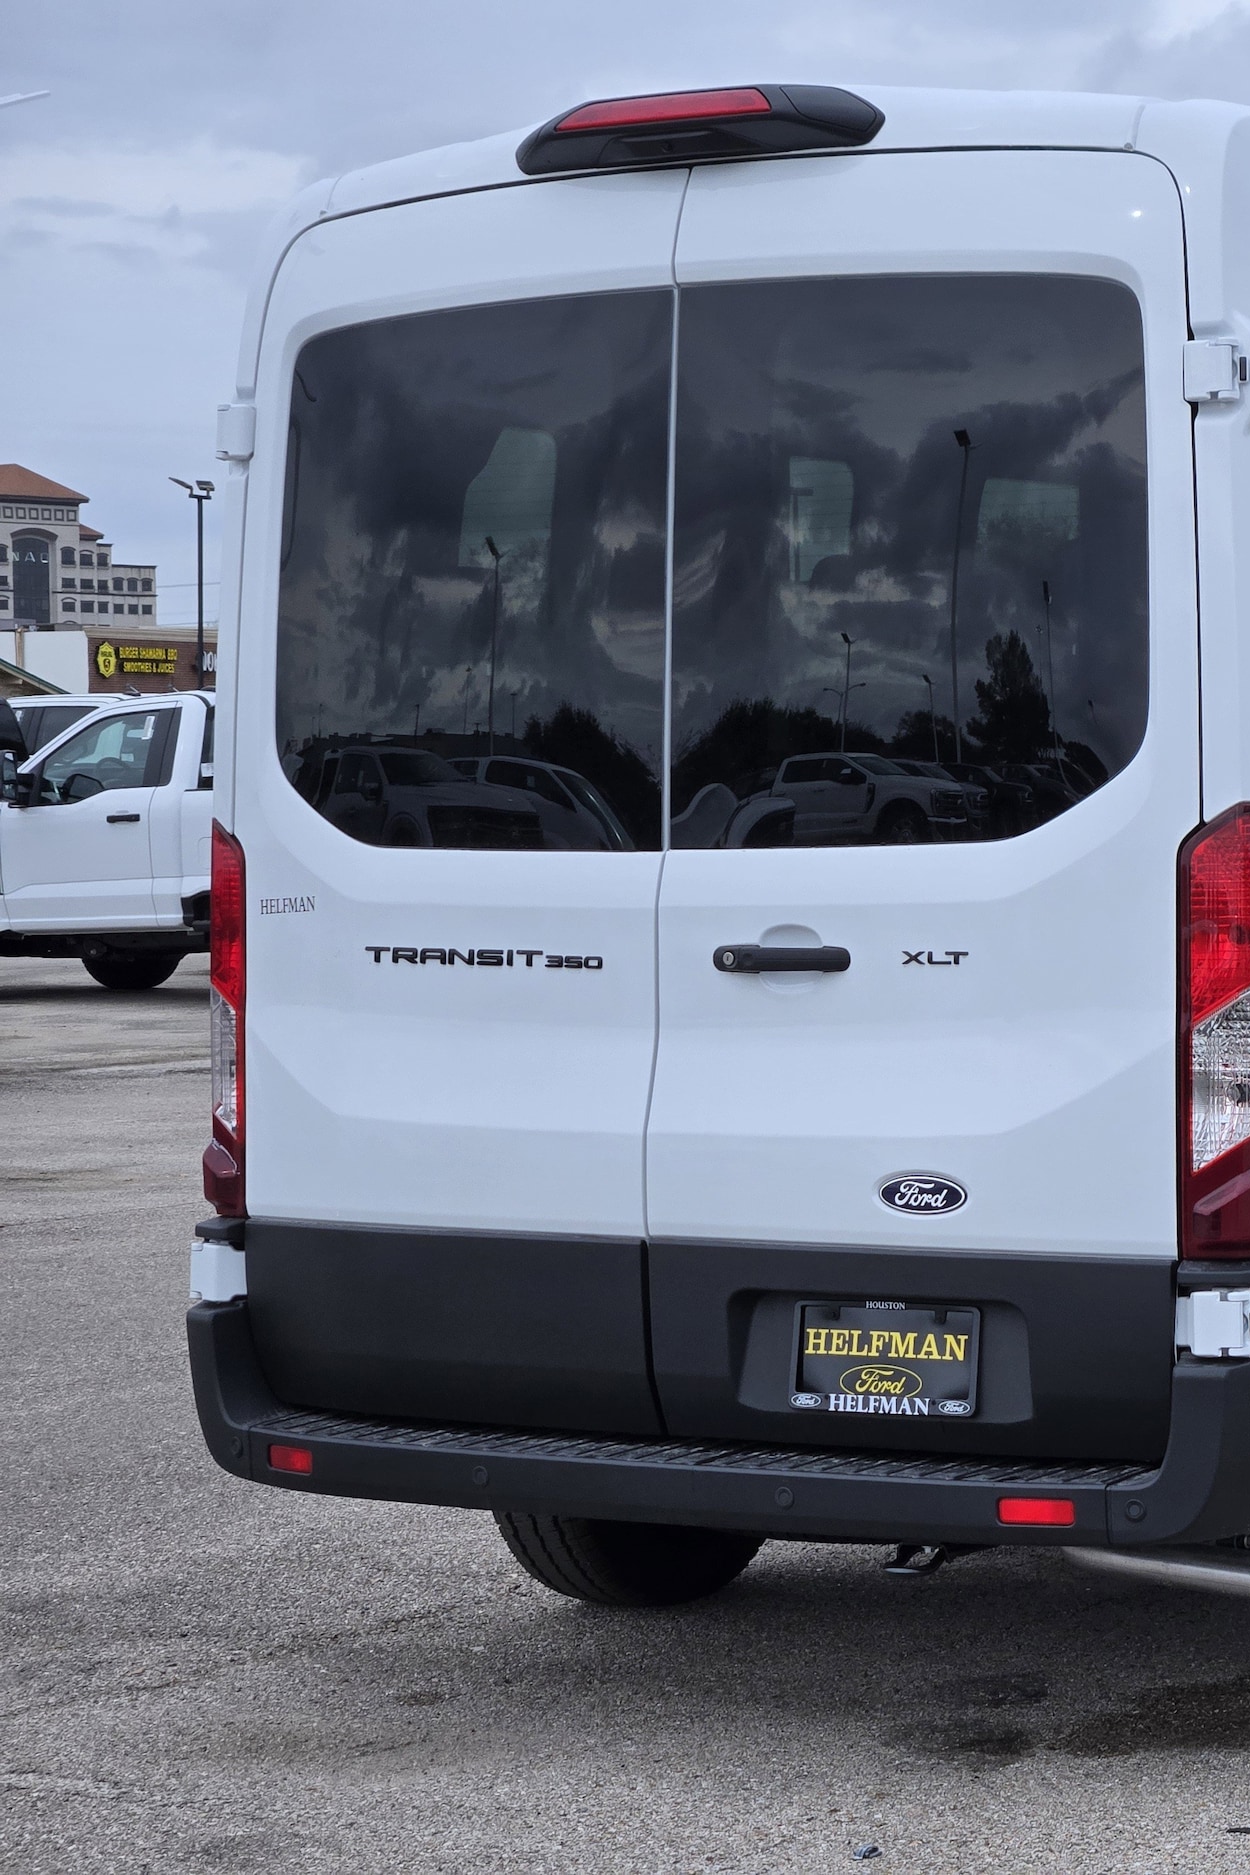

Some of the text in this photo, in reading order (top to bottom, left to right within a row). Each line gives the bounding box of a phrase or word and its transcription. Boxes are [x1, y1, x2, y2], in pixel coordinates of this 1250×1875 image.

[123, 661, 152, 673] SMOOTHIES
[157, 662, 175, 674] JUICES
[260, 895, 316, 915] HELFMAN
[901, 950, 969, 965] XLT
[894, 1180, 949, 1208] Ford
[865, 1300, 906, 1311] HOUSTON
[805, 1328, 969, 1361] HELFMAN
[855, 1368, 907, 1395] Ford
[796, 1395, 816, 1406] Ford
[828, 1393, 930, 1416] HELFMAN
[943, 1402, 964, 1413] Ford
